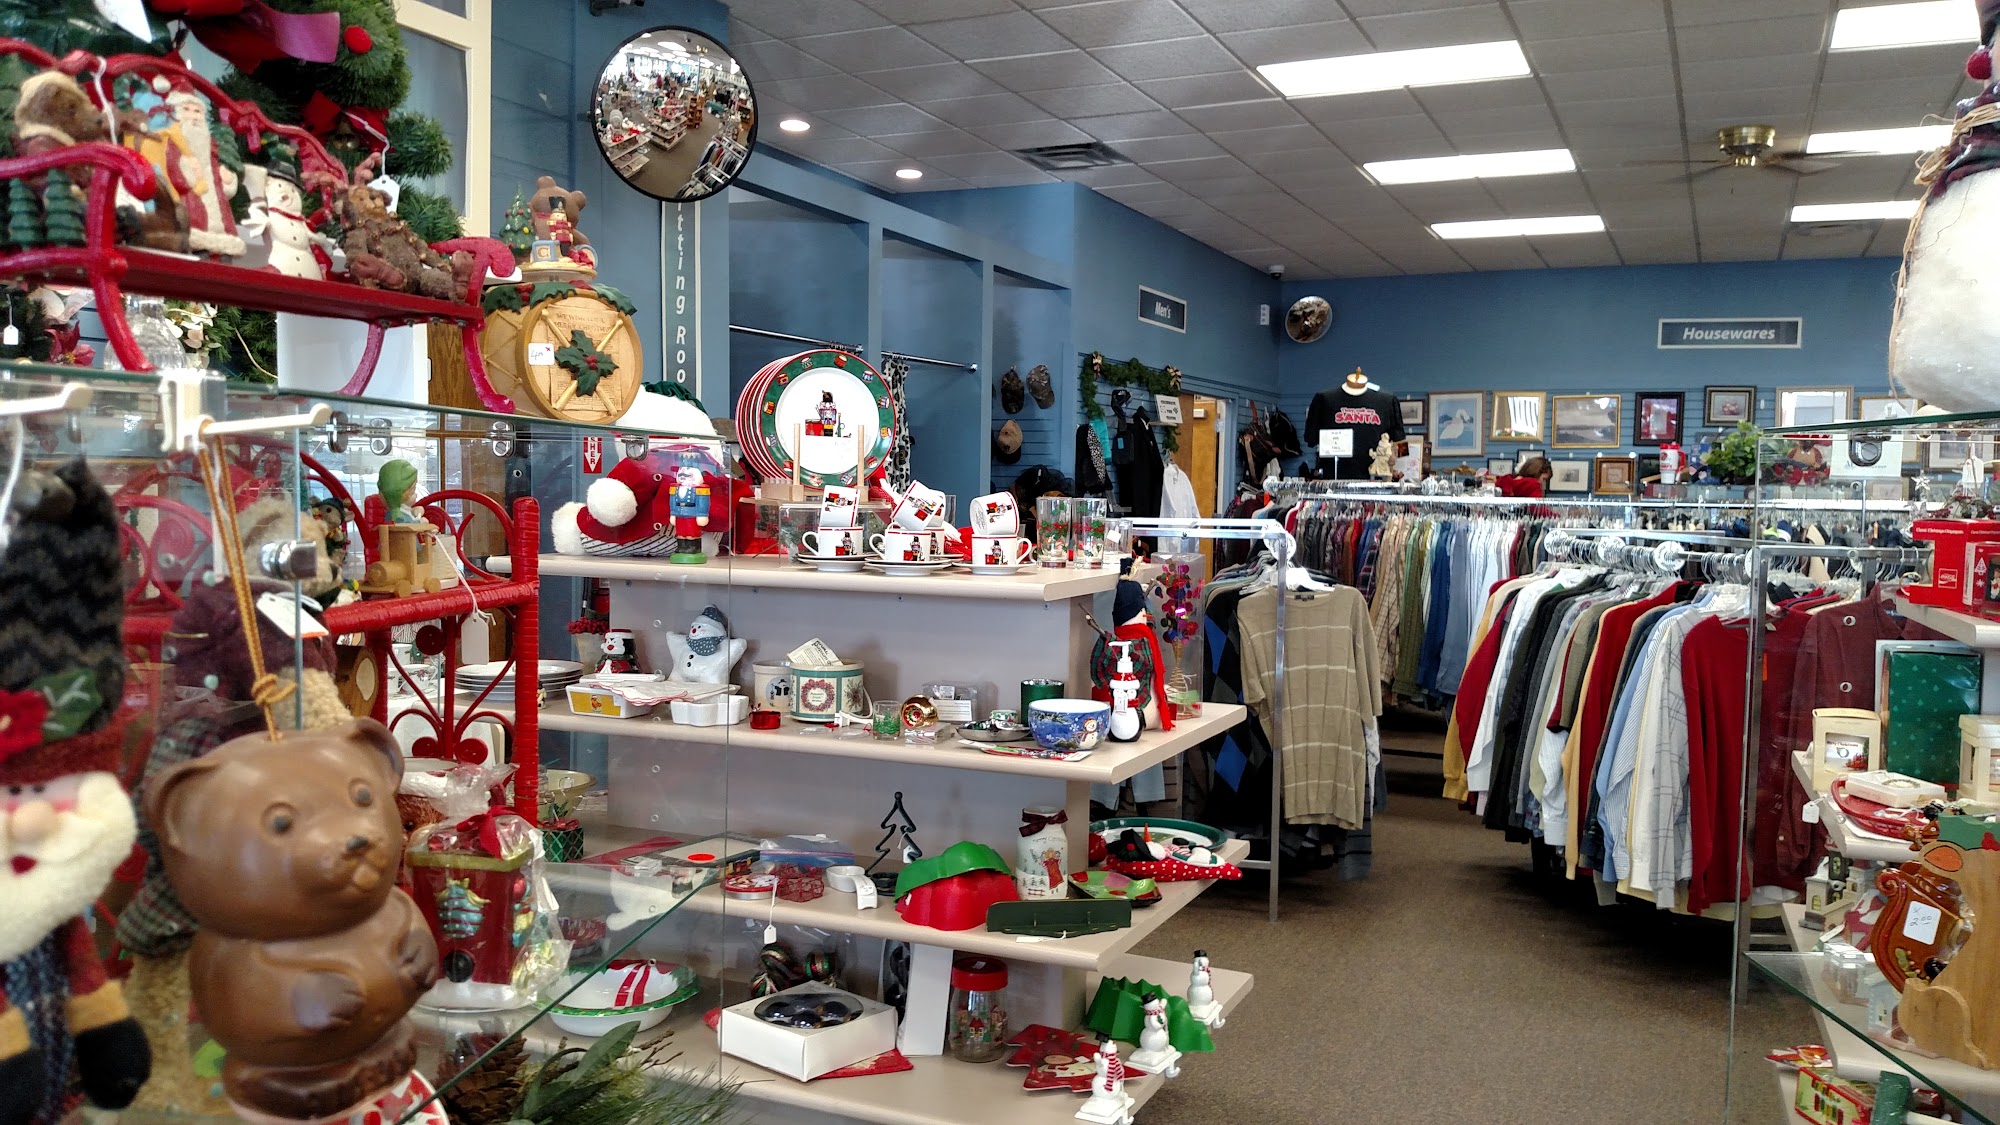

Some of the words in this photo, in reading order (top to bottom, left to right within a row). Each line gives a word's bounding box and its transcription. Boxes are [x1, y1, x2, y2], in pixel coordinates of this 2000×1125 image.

[1154, 301, 1171, 319] Men's
[1682, 327, 1776, 340] Housewares
[676, 325, 687, 384] Roo
[1335, 412, 1381, 425] SANTA
